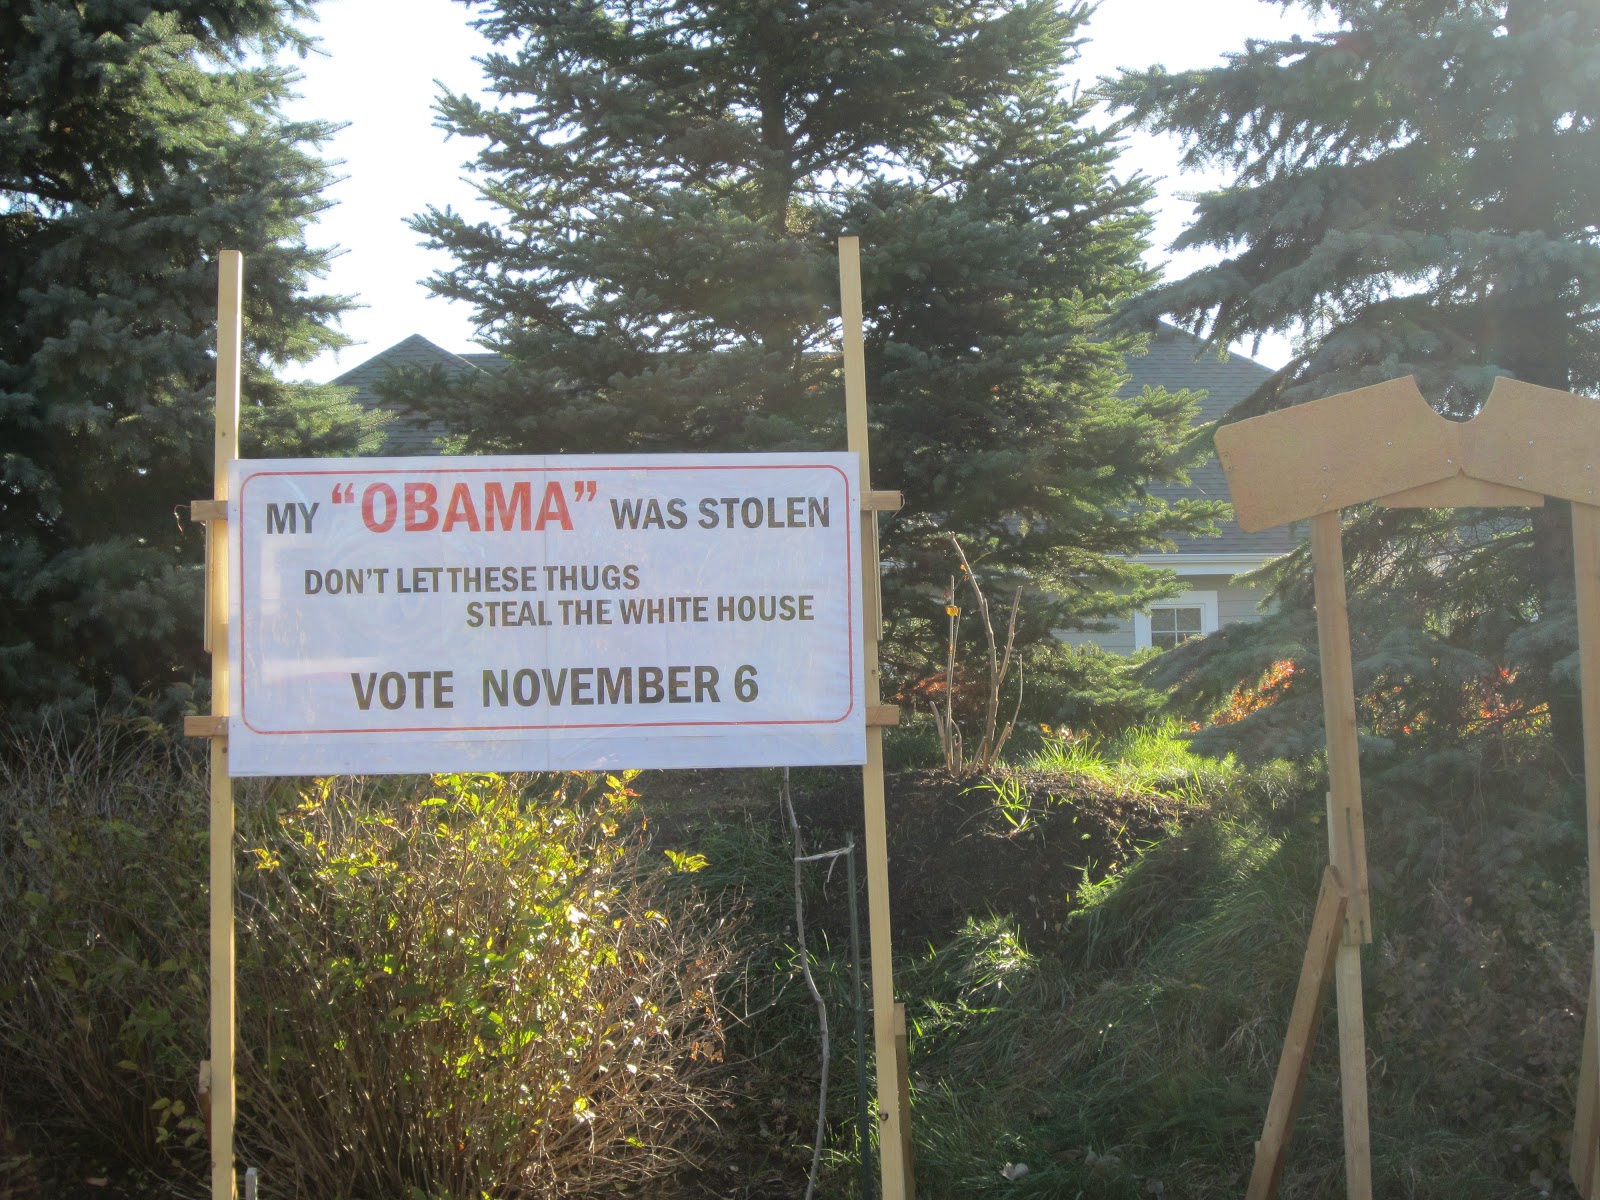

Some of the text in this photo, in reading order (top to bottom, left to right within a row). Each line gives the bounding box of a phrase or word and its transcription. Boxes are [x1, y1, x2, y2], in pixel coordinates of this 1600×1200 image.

[267, 480, 830, 535] MY “OBAMA” WAS STOLEN
[304, 564, 640, 595] DON’T LET THESE THUGS
[466, 595, 815, 627] STEAL THE WHITE HOUSE
[351, 664, 759, 710] VOTE NOVEMBER 6
